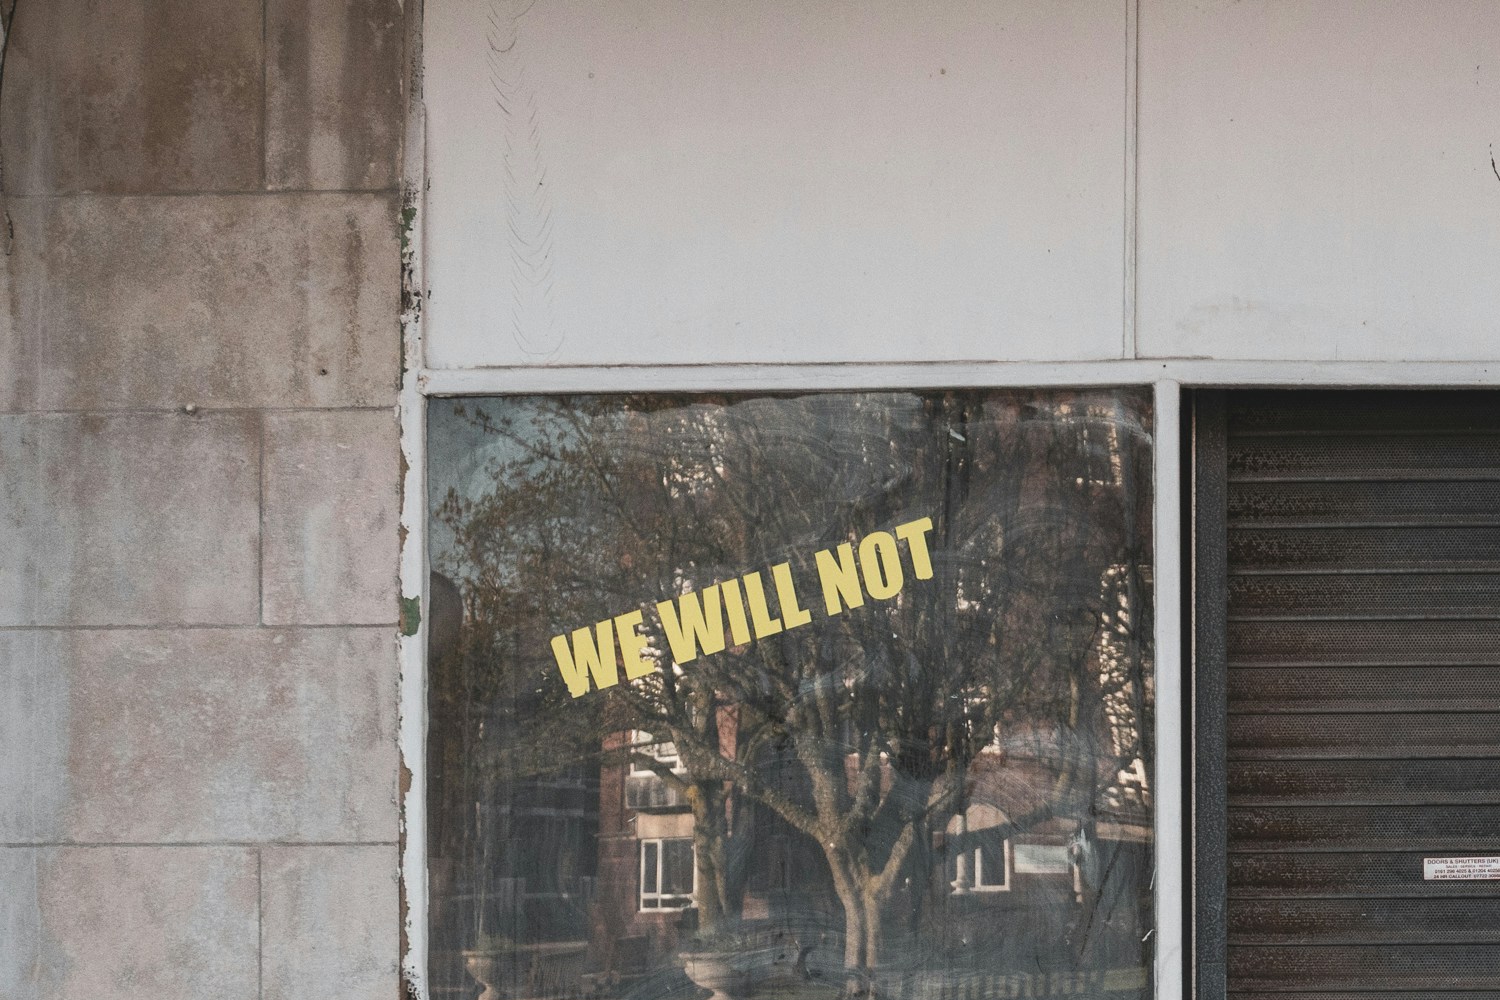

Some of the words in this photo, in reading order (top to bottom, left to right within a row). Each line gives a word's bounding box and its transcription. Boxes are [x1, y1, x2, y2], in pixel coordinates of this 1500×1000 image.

[550, 609, 655, 699] WE
[656, 561, 812, 665] WILL
[814, 517, 934, 617] NOT
